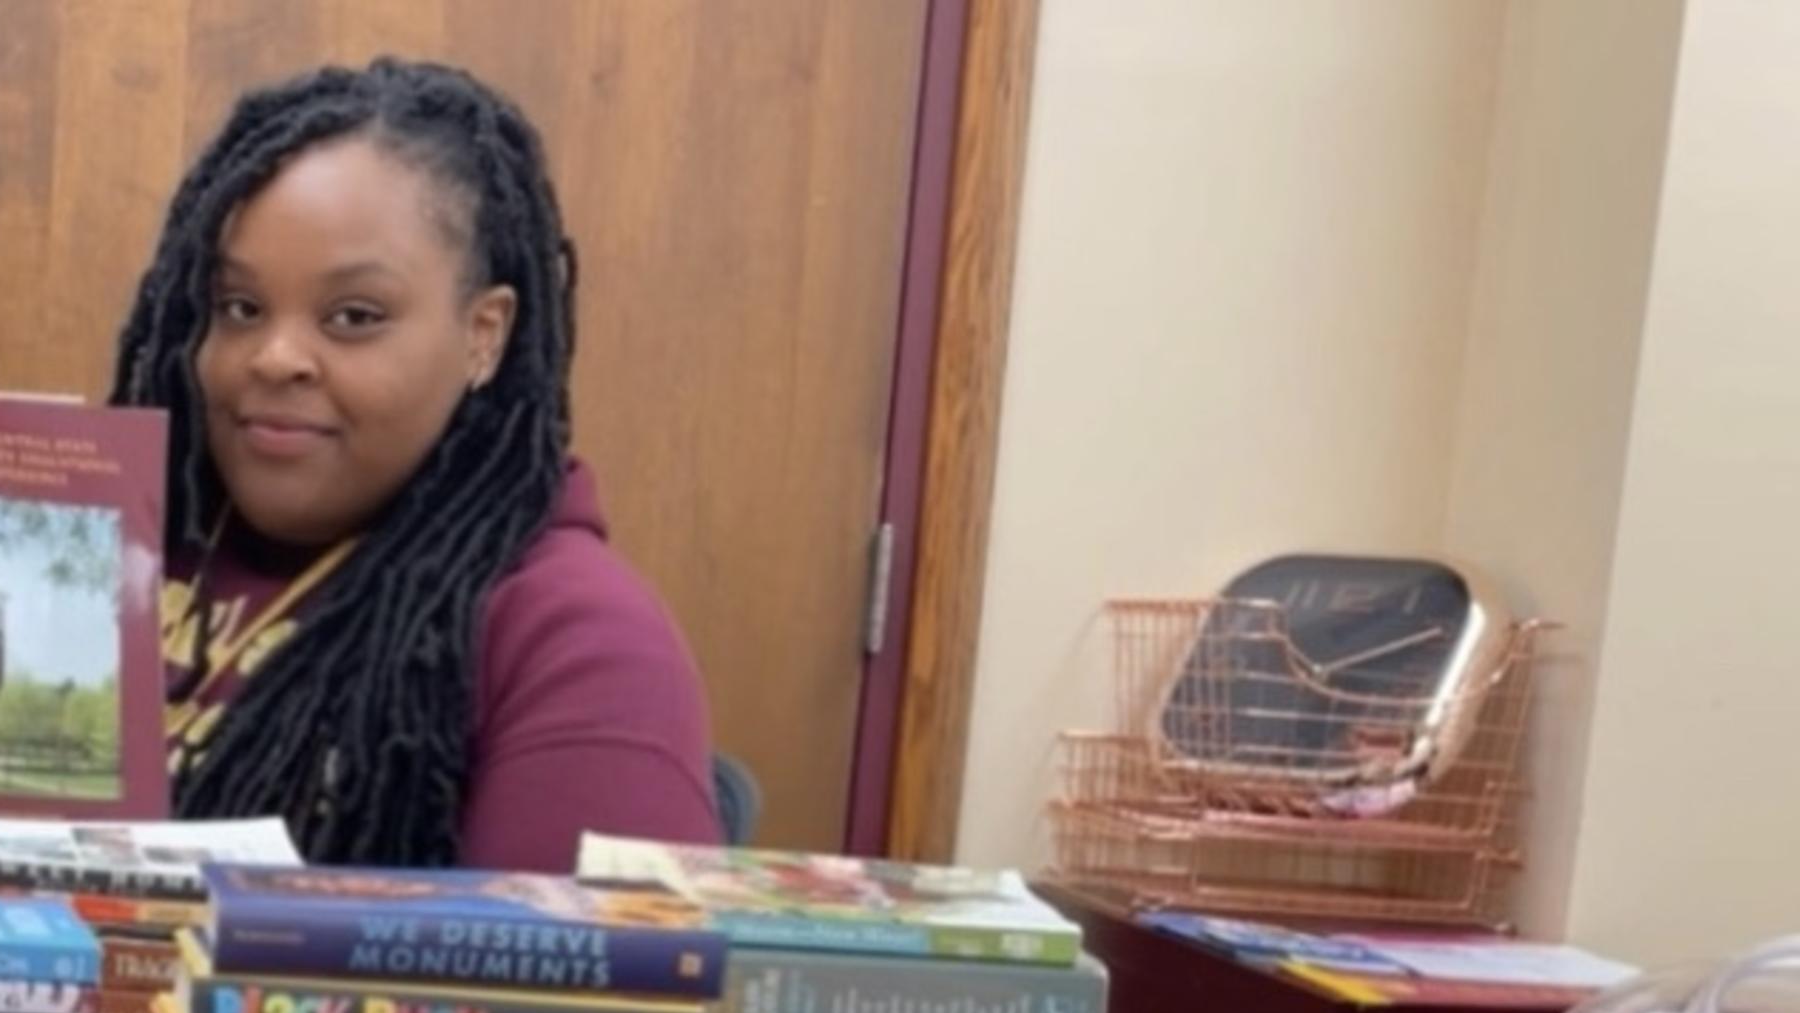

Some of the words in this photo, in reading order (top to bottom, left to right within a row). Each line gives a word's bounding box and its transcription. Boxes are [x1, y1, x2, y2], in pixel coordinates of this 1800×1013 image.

[359, 916, 421, 943] WE
[441, 918, 609, 955] DESERVE
[350, 946, 611, 988] MONUMENTS
